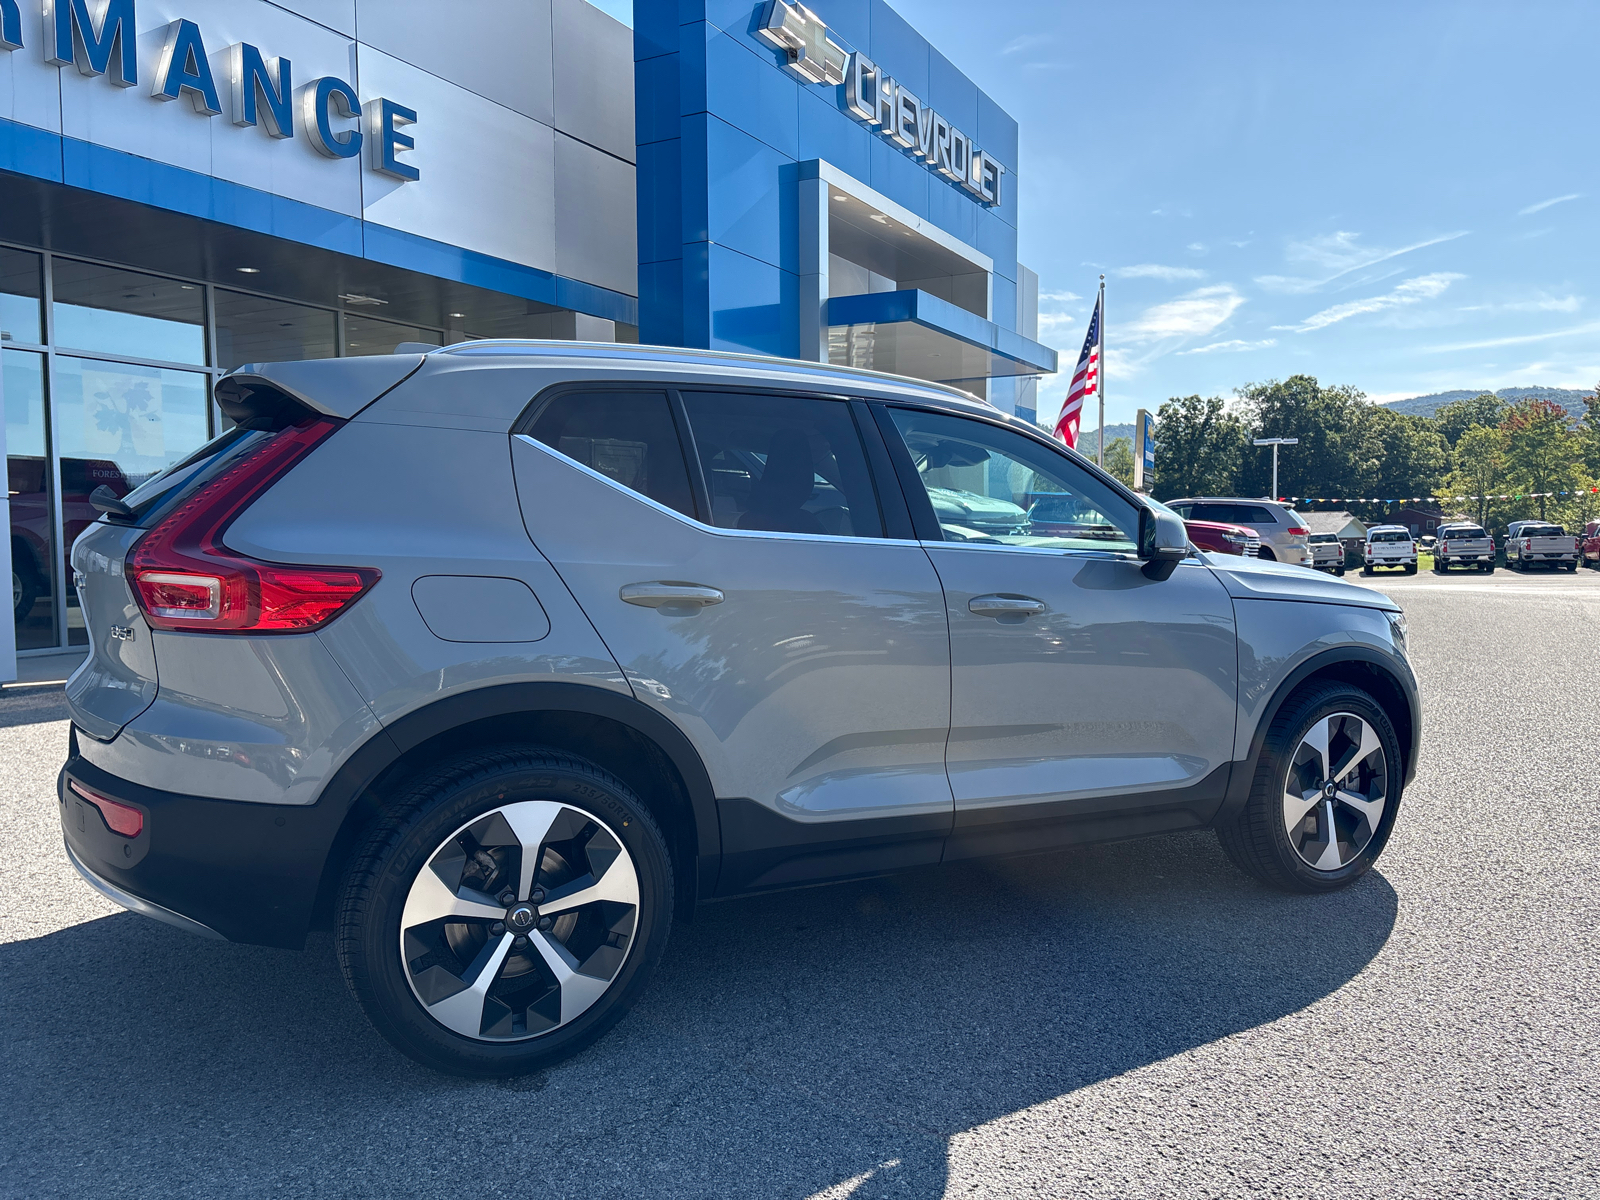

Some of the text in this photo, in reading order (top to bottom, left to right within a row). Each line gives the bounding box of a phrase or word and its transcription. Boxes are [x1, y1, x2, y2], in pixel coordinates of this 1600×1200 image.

[0, 0, 420, 182] MANCE
[848, 51, 1005, 207] CHEVROLET
[394, 780, 510, 872] ULTRAMAX
[571, 783, 634, 825] 235/50R19
